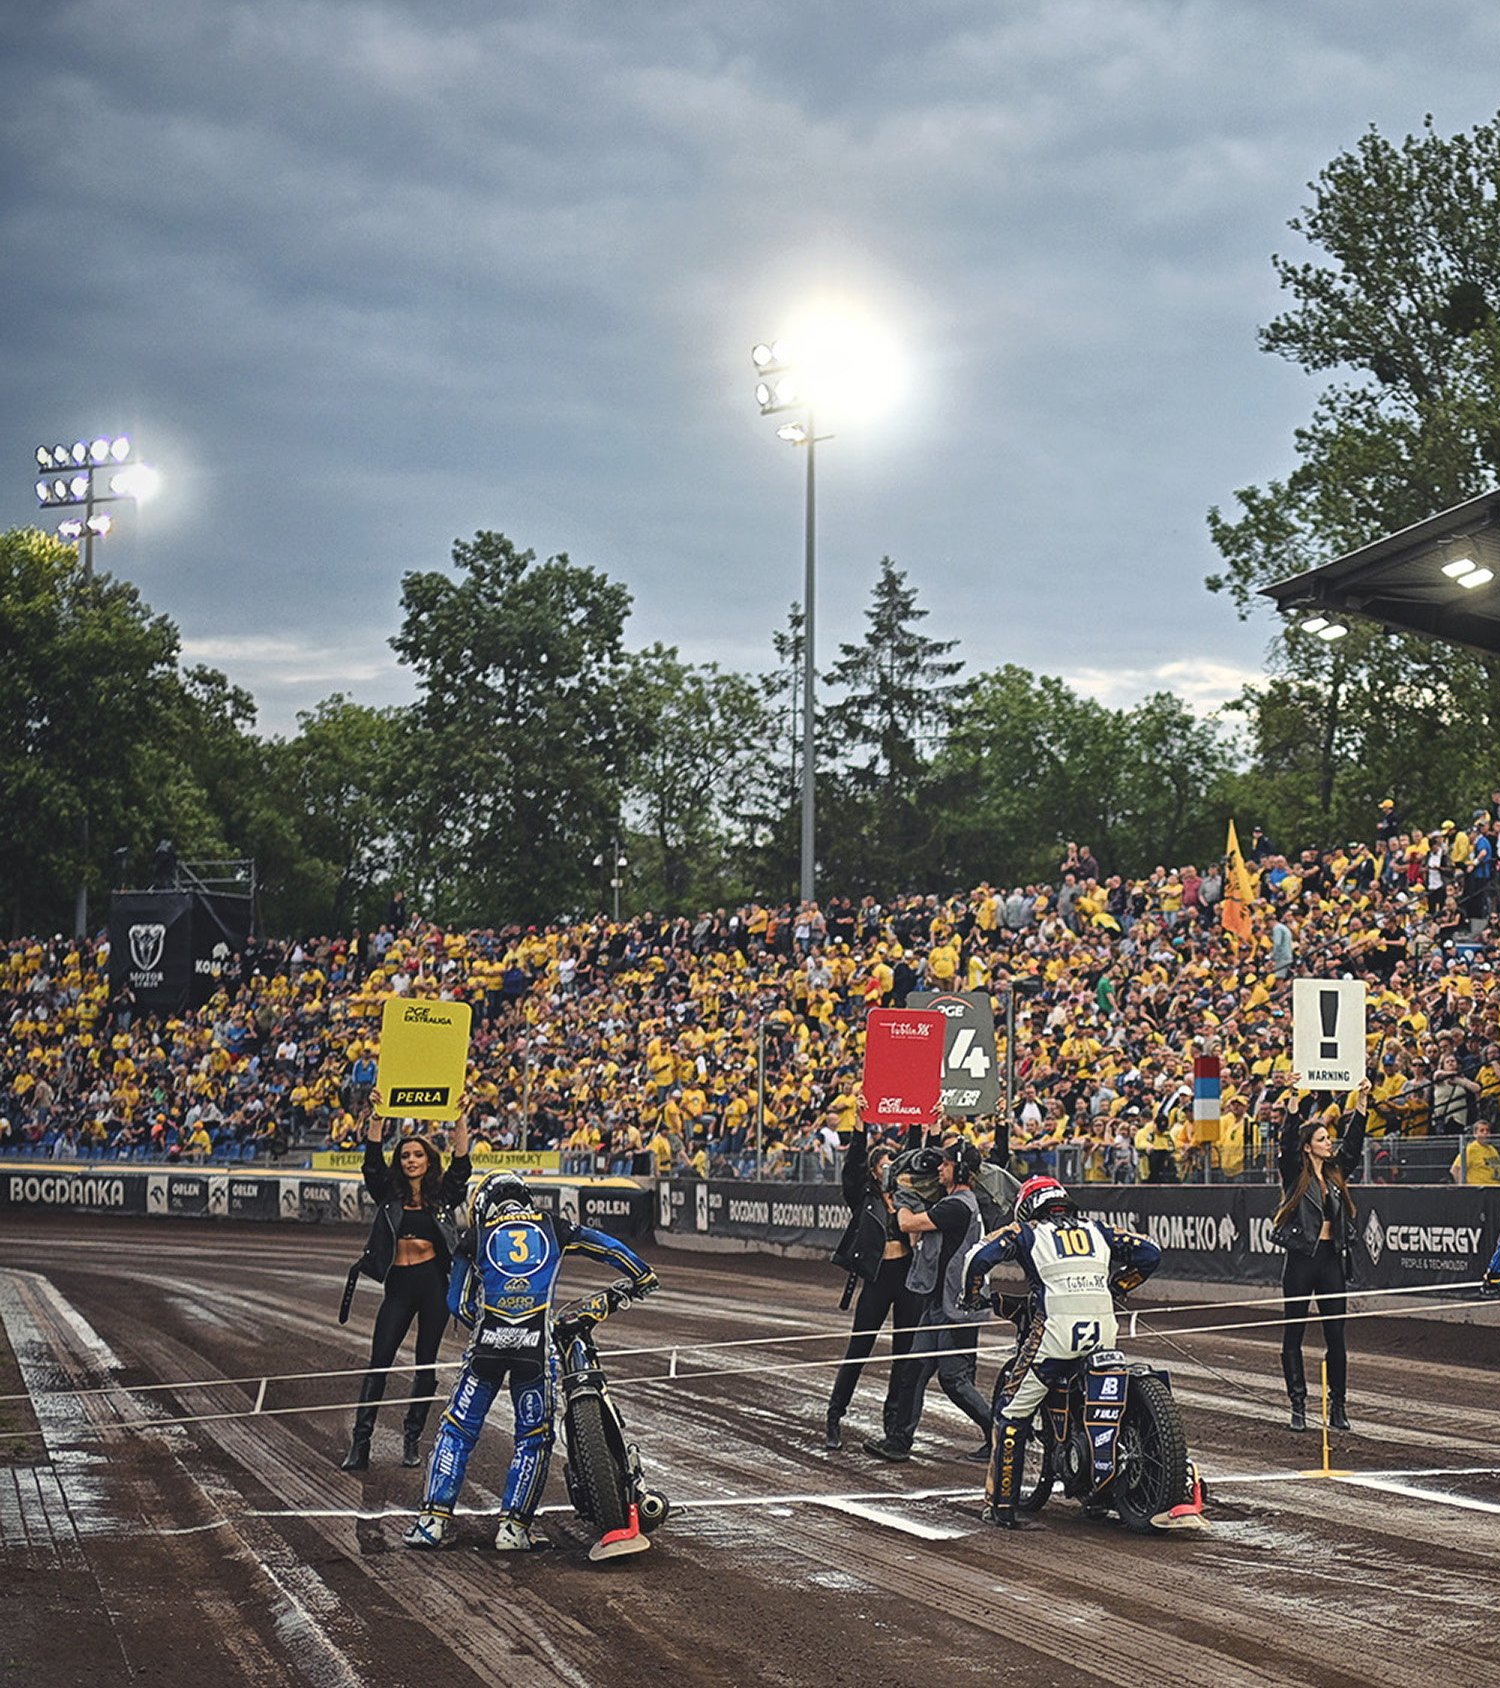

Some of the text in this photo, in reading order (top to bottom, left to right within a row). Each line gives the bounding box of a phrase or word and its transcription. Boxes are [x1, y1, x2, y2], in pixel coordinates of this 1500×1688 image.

[404, 1006, 431, 1017] PGE
[1308, 1070, 1351, 1082] WARNING
[396, 1091, 442, 1104] PERŁA
[9, 1176, 124, 1206] BOGDANKA
[171, 1183, 200, 1197] ORLEN
[232, 1184, 259, 1198] ORLEN
[585, 1200, 631, 1216] ORLEN
[772, 1202, 815, 1228] BOGDANKA
[508, 1230, 529, 1263] 3
[1057, 1228, 1091, 1257] 10
[1386, 1225, 1482, 1254] GCENERGY
[453, 1376, 479, 1420] LAVOR
